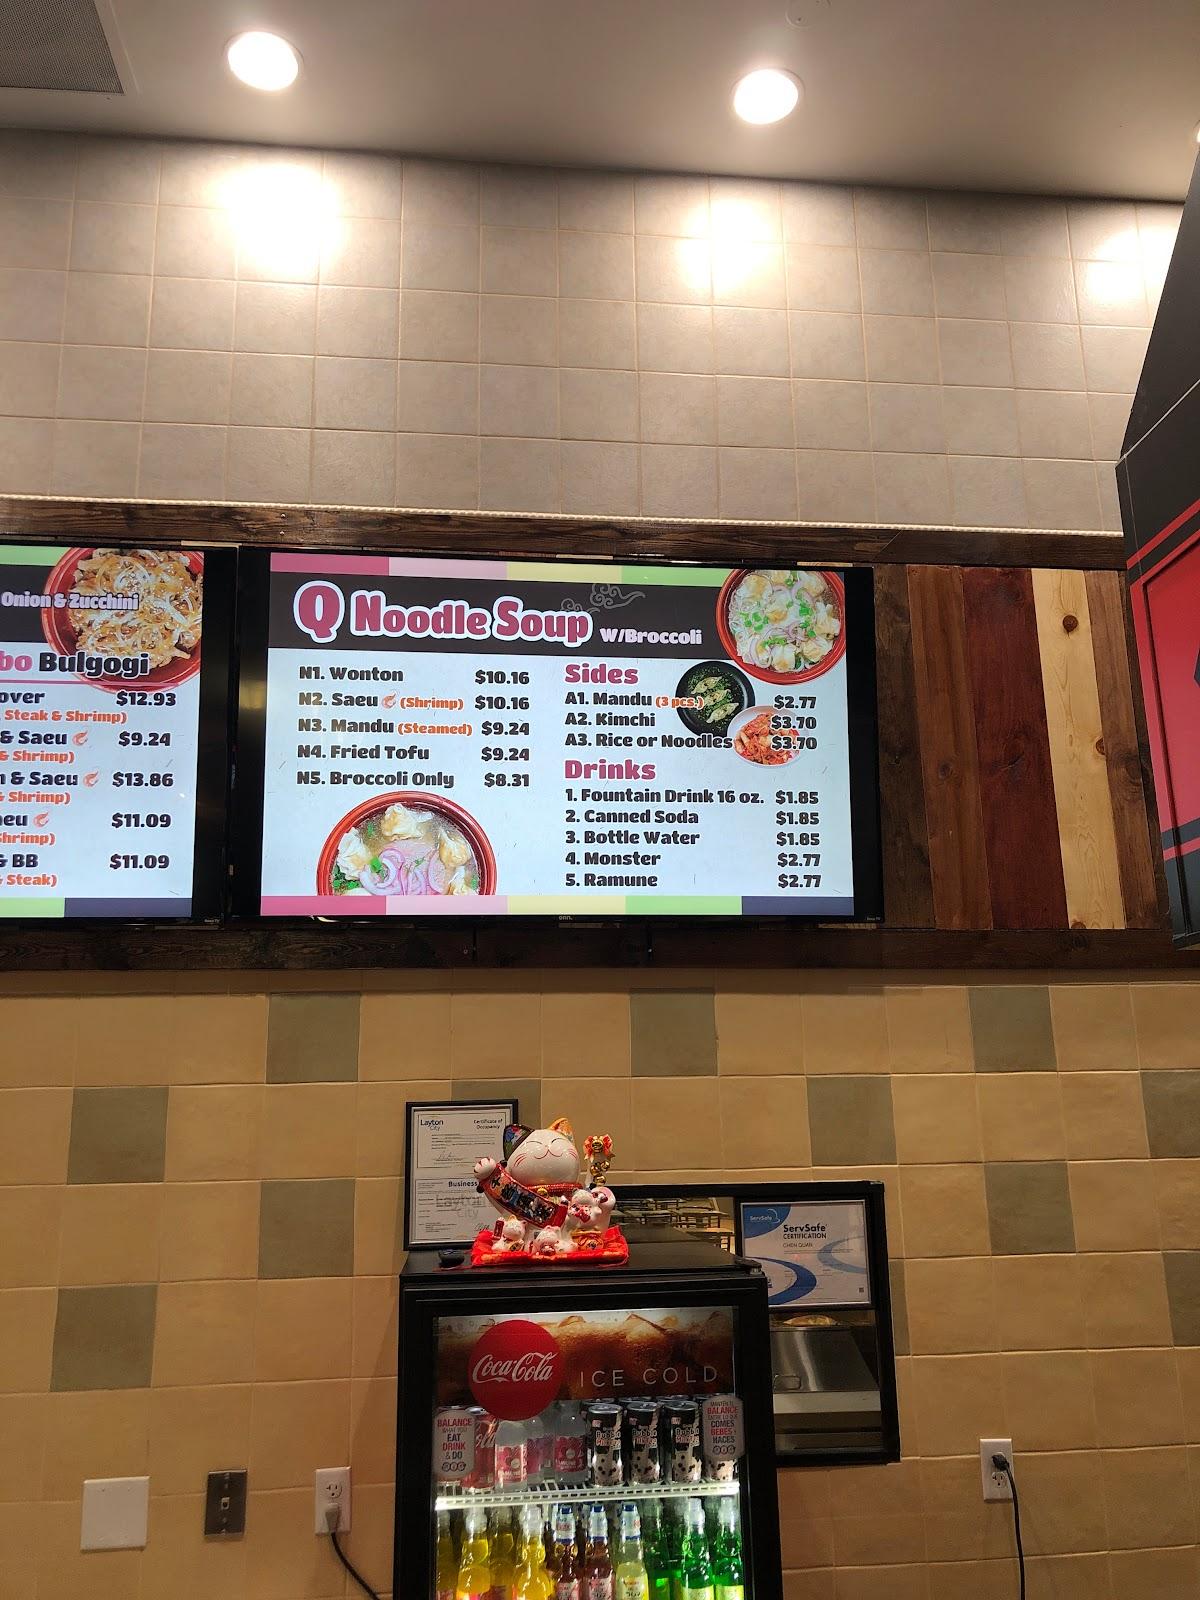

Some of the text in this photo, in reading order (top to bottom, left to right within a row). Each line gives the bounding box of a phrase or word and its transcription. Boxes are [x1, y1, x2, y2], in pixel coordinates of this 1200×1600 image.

[1, 591, 139, 610] Onion & Zucchini
[294, 581, 703, 648] Q Noodle Soup W/Broccoli
[39, 651, 150, 679] Bulgogi
[299, 666, 530, 685] N1. Wonton $10.16
[564, 663, 639, 685] Sides
[116, 691, 177, 707] $12.93
[298, 692, 530, 711] N2. Saeu (Shrimp) $10.16
[564, 692, 817, 710] A1. Mandu (3 pcs.) $2.77
[4, 709, 127, 725] Steak & Shrimp)
[564, 712, 818, 731] A2. Kimchi $3.70
[298, 718, 530, 737] N3. Mandu (Steamed) $9.24
[0, 731, 171, 747] & Saeu $9.24
[564, 733, 818, 751] A3. Rice or Noodles $3.70
[12, 750, 75, 764] Shrimp)
[297, 744, 530, 762] N4. Fried Tofu $9.24
[564, 759, 657, 781] Drinks
[10, 772, 25, 786] &
[29, 772, 79, 786] Saeu
[112, 772, 174, 788] $13.86
[296, 771, 530, 789] N5. Broccoli Only $8.31
[8, 790, 71, 805] Shrimp)
[566, 788, 819, 805] 1. Fountain Drink 16 oz. $1.85
[111, 813, 171, 829] $11.09
[565, 809, 820, 826] 2. Canned Soda $1.85
[565, 830, 820, 847] 3. Bottle Water $1.85
[12, 854, 39, 868] BB
[109, 854, 170, 870] $11.09
[565, 851, 821, 868] 4. Monster $2.77
[6, 873, 57, 887] Steak)
[565, 873, 822, 889] 5. Ramune $2.77
[420, 1119, 444, 1128] Layton
[448, 1180, 478, 1188] Business
[783, 1223, 826, 1233] ServSafe
[783, 1232, 827, 1240] CERTIFICATION
[580, 1366, 719, 1388] ICE COLD
[438, 1418, 472, 1427] BALANCE
[710, 1420, 735, 1428] COMES
[447, 1433, 461, 1442] EAT
[712, 1435, 735, 1443] HACES
[442, 1442, 466, 1451] DRINK
[452, 1451, 463, 1460] DO
